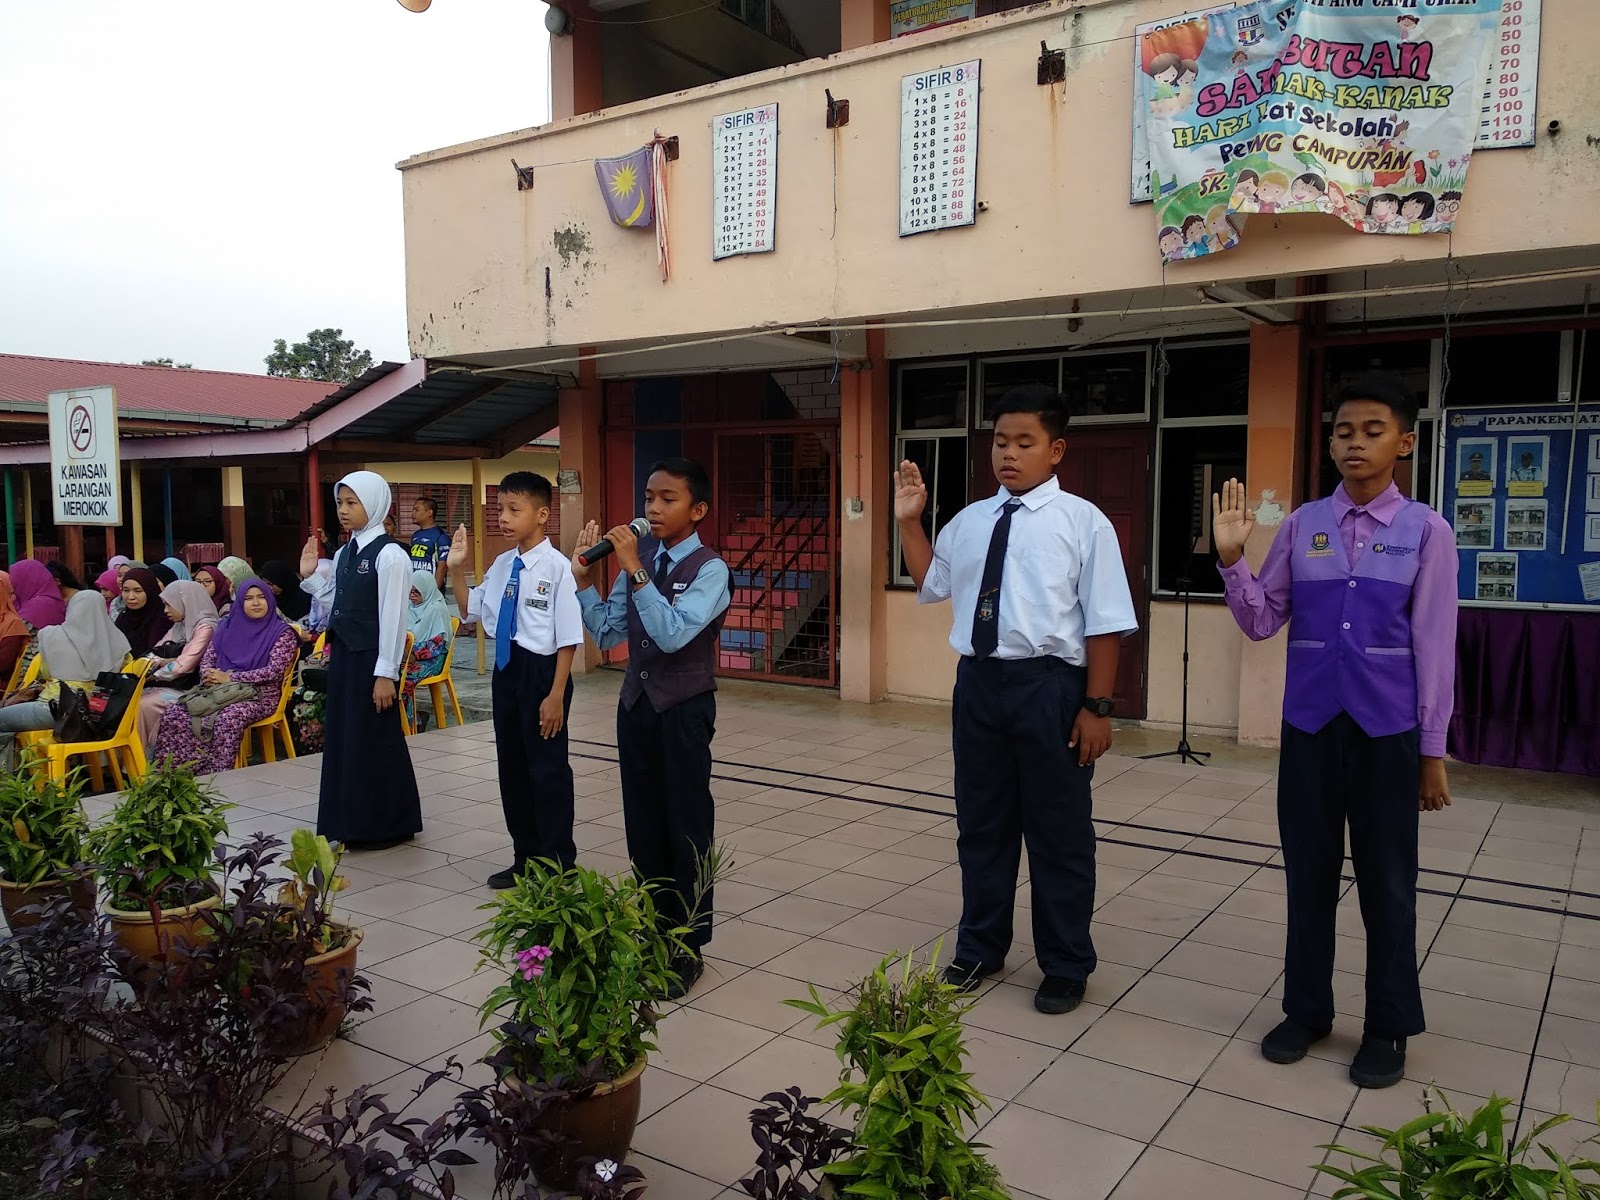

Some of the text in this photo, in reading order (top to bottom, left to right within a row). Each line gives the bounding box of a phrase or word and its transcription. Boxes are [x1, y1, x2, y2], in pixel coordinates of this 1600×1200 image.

[1503, 1, 1522, 13] 30
[1502, 15, 1522, 26] 40
[1501, 30, 1521, 41] 50
[1501, 44, 1520, 55] 60
[1500, 58, 1520, 70] 70
[916, 68, 964, 90] SIFIR 8
[1500, 73, 1519, 84] 80
[915, 98, 918, 106] 1
[931, 94, 936, 102] 8
[958, 88, 963, 96] 8
[1499, 87, 1518, 98] 90
[914, 109, 919, 117] 2
[931, 105, 936, 113] 8
[955, 99, 966, 108] 16
[1494, 101, 1523, 113] 100
[725, 110, 764, 128] SIFIR 7
[914, 120, 919, 128] 3
[954, 110, 966, 120] 24
[1299, 106, 1393, 137] Sekolah
[1493, 115, 1522, 127] 110
[914, 131, 919, 139] 4
[930, 128, 935, 136] 8
[954, 122, 966, 131] 32
[1172, 109, 1251, 148] HARI
[1493, 129, 1521, 141] 120
[757, 138, 767, 146] 14
[914, 142, 918, 150] 5
[930, 139, 935, 147] 8
[953, 133, 966, 142] 40
[757, 148, 766, 156] 21
[930, 150, 935, 158] 8
[953, 145, 965, 153] 48
[1293, 135, 1413, 170] CAMPURAN
[757, 158, 766, 166] 28
[913, 164, 918, 172] 7
[930, 161, 935, 169] 8
[953, 156, 965, 165] 56
[757, 169, 766, 177] 35
[929, 172, 934, 180] 8
[952, 167, 964, 176] 64
[929, 183, 934, 191] 8
[952, 178, 964, 187] 72
[756, 199, 766, 207] 56
[911, 197, 920, 206] 10
[932, 194, 936, 202] 8
[952, 190, 963, 198] 80
[756, 209, 765, 217] 63
[910, 208, 919, 217] 11
[931, 205, 936, 213] 8
[952, 201, 963, 209] 88
[910, 219, 920, 228] 12
[931, 216, 936, 224] 8
[951, 212, 963, 220] 96
[722, 244, 730, 252] 12
[61, 463, 107, 479] KAWASAN
[59, 483, 111, 498] LARANGAN
[63, 501, 108, 516] MEROKOK
[411, 544, 428, 557] 46
